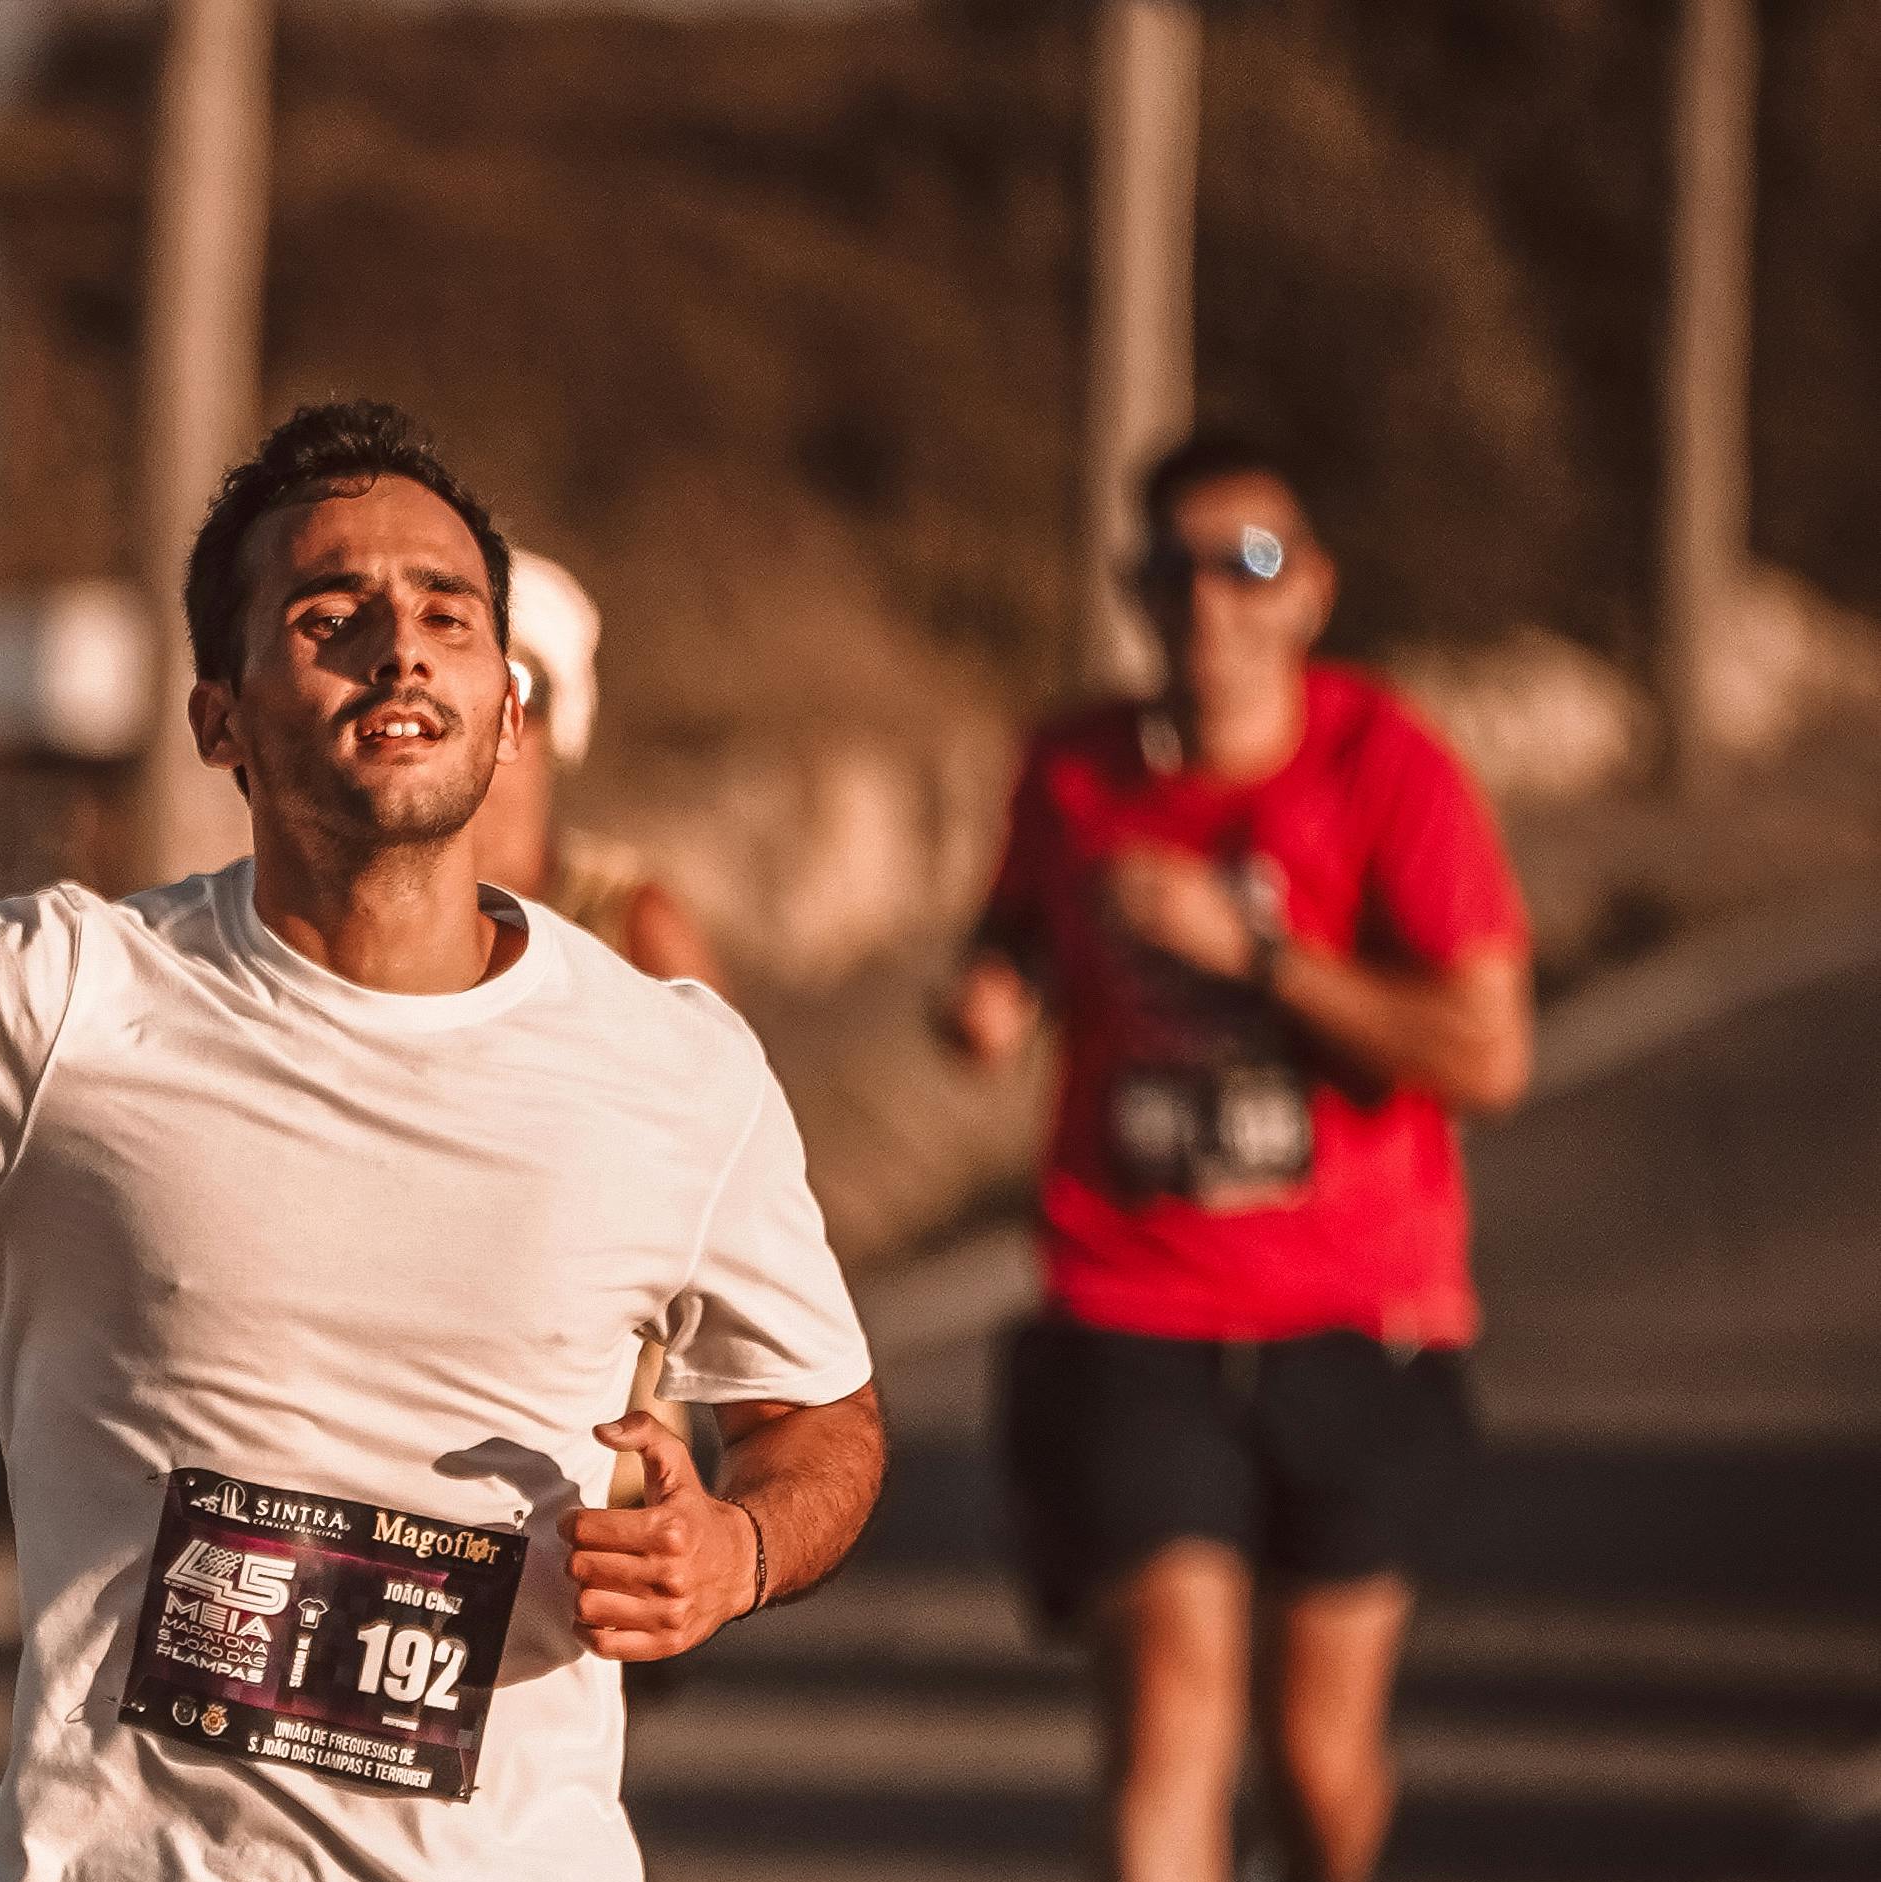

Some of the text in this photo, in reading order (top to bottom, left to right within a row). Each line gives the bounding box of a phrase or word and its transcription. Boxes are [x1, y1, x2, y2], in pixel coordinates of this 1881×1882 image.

[255, 1499, 344, 1531] SINTRA
[383, 1582, 425, 1608] JOÃO
[160, 1615, 268, 1656] MARATONA
[165, 1591, 272, 1642] MEIA
[156, 1643, 265, 1684] #LAMPAS
[158, 1628, 268, 1669] S. JOÃO DAS
[357, 1624, 466, 1711] 192
[247, 1736, 433, 1789] S. JOÃO DAS LAMPAS E TERRUGEM
[274, 1720, 416, 1766] UNIÃO DE FREGUESIAS DE
